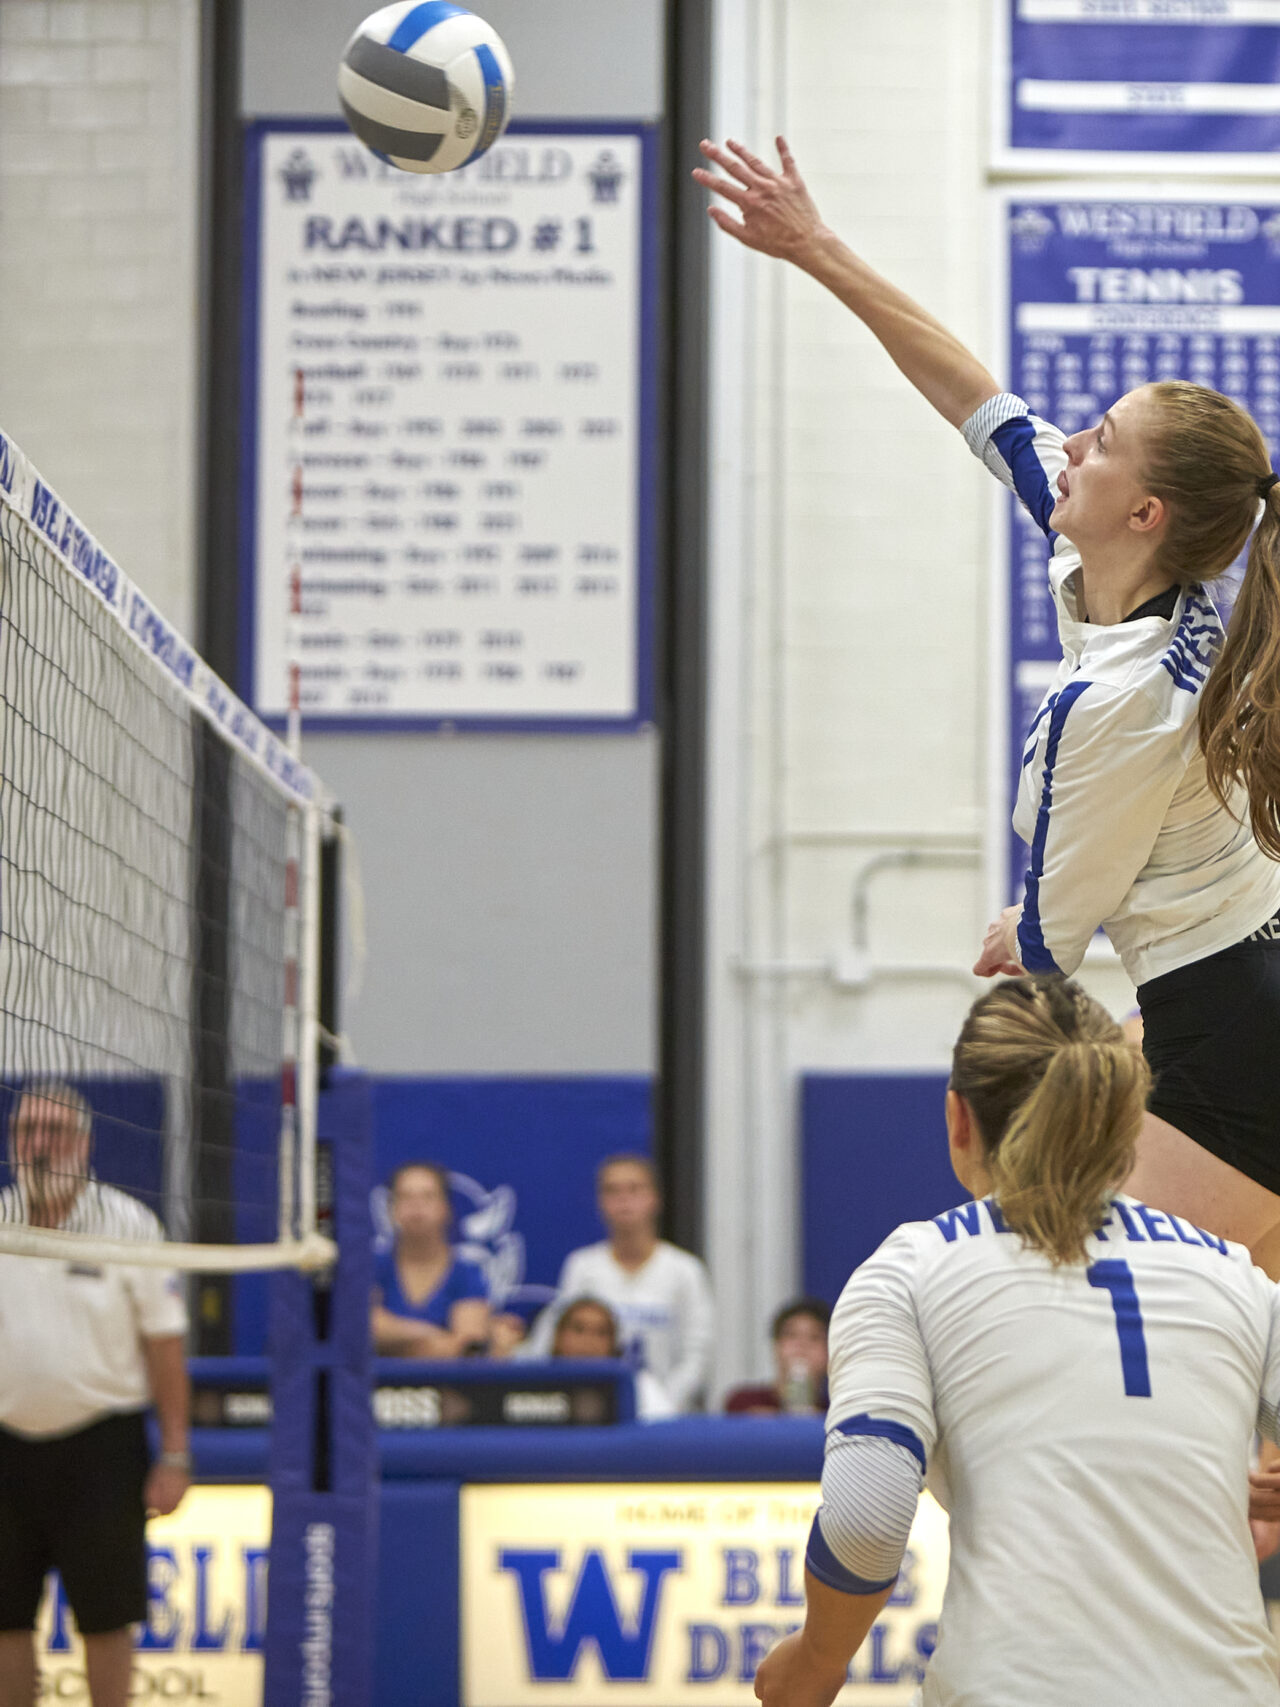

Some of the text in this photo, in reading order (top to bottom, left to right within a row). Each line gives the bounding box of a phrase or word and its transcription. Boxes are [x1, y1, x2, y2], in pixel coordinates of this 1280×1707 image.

[304, 214, 519, 251] RANKED
[1056, 205, 1259, 242] WESTFIELD
[1067, 267, 1244, 303] TENNIS
[1086, 1258, 1152, 1398] 1
[721, 1547, 924, 1607] BLE
[498, 1546, 683, 1685] W
[687, 1621, 940, 1685] DELS
